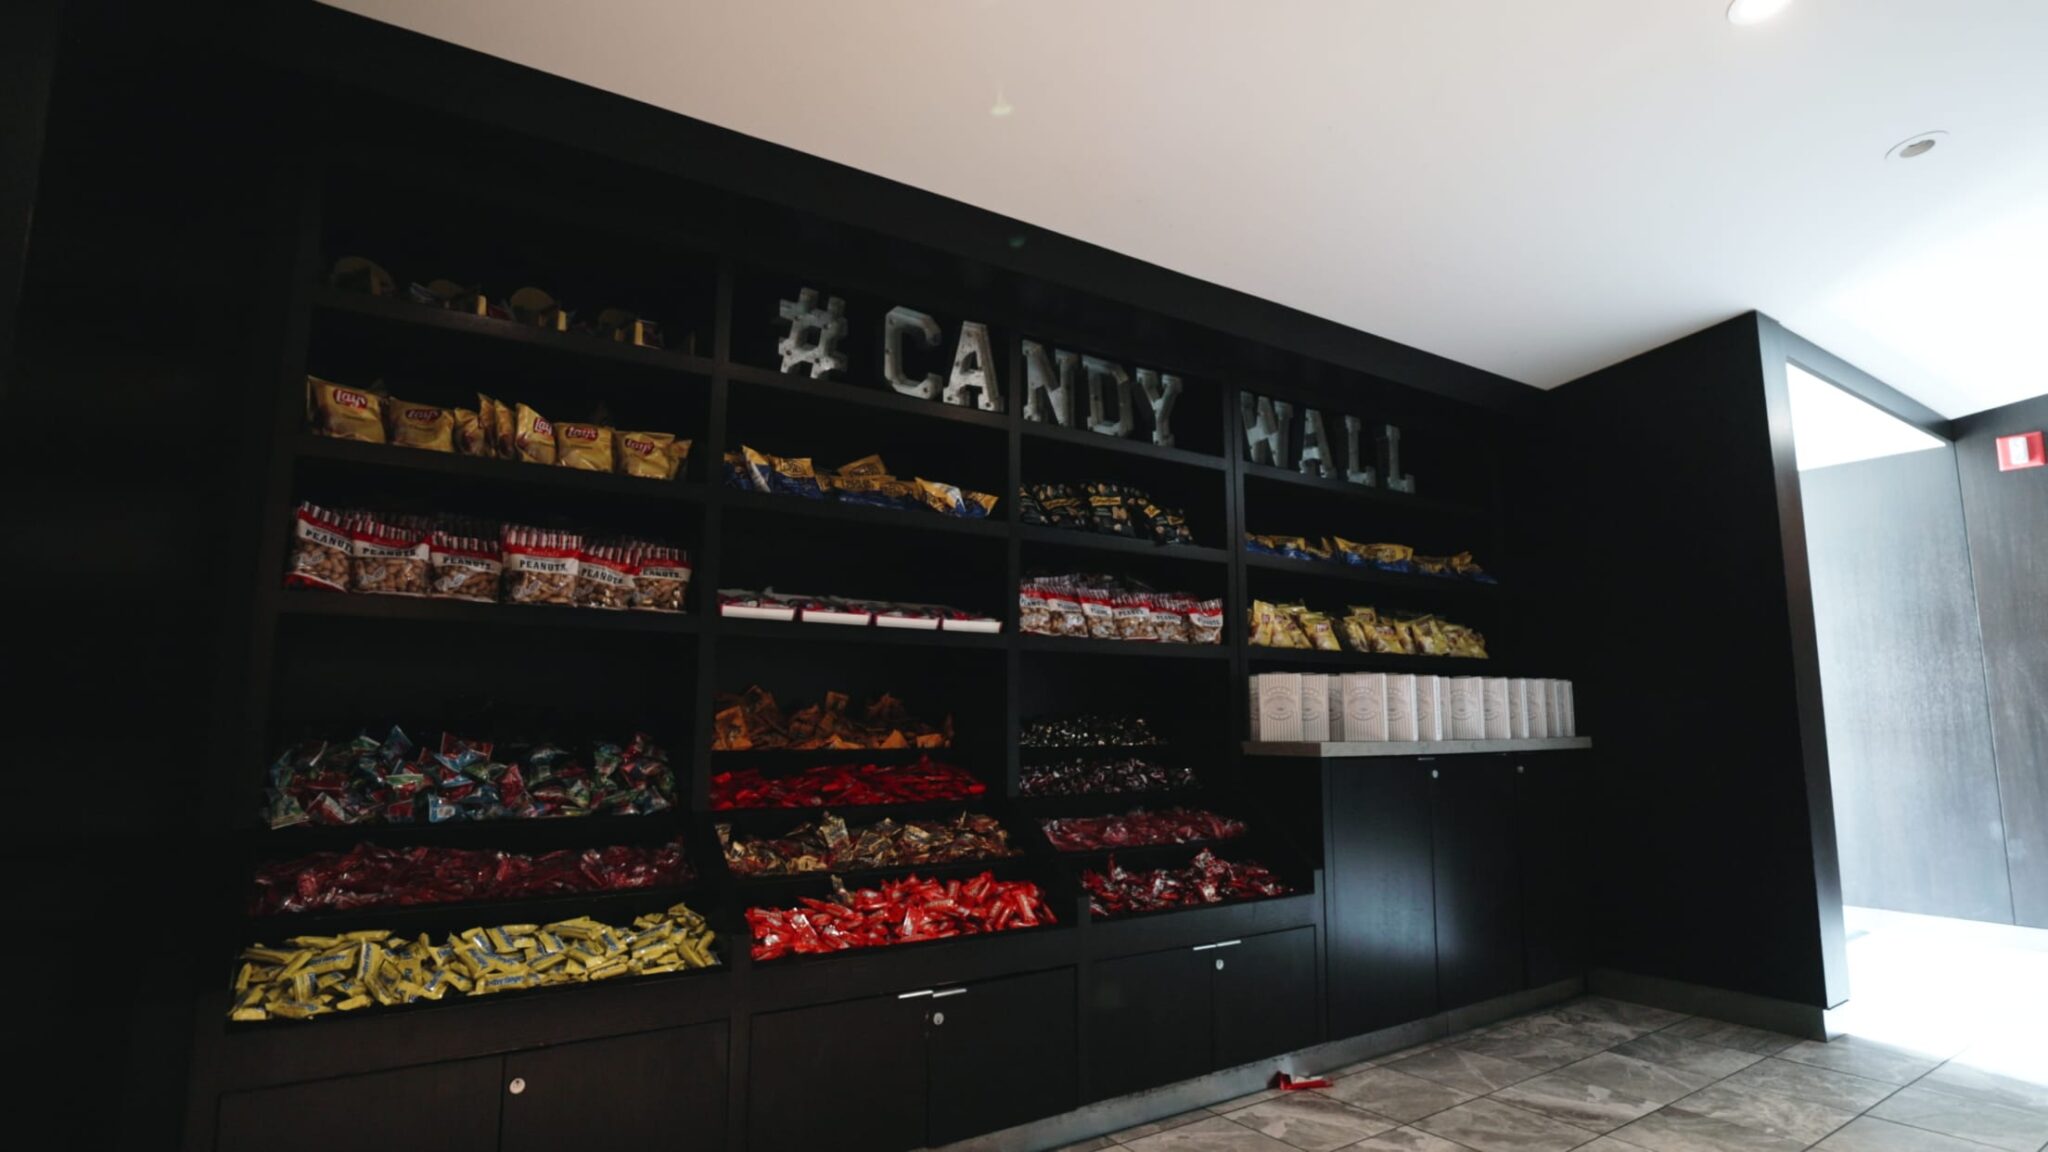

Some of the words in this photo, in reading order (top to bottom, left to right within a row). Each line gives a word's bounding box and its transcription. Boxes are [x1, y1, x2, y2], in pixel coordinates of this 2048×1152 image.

[1240, 390, 1416, 494] WALL
[363, 547, 416, 557] PEANUTS
[443, 556, 491, 570] PEANUTS
[520, 559, 567, 571] PEANUTS
